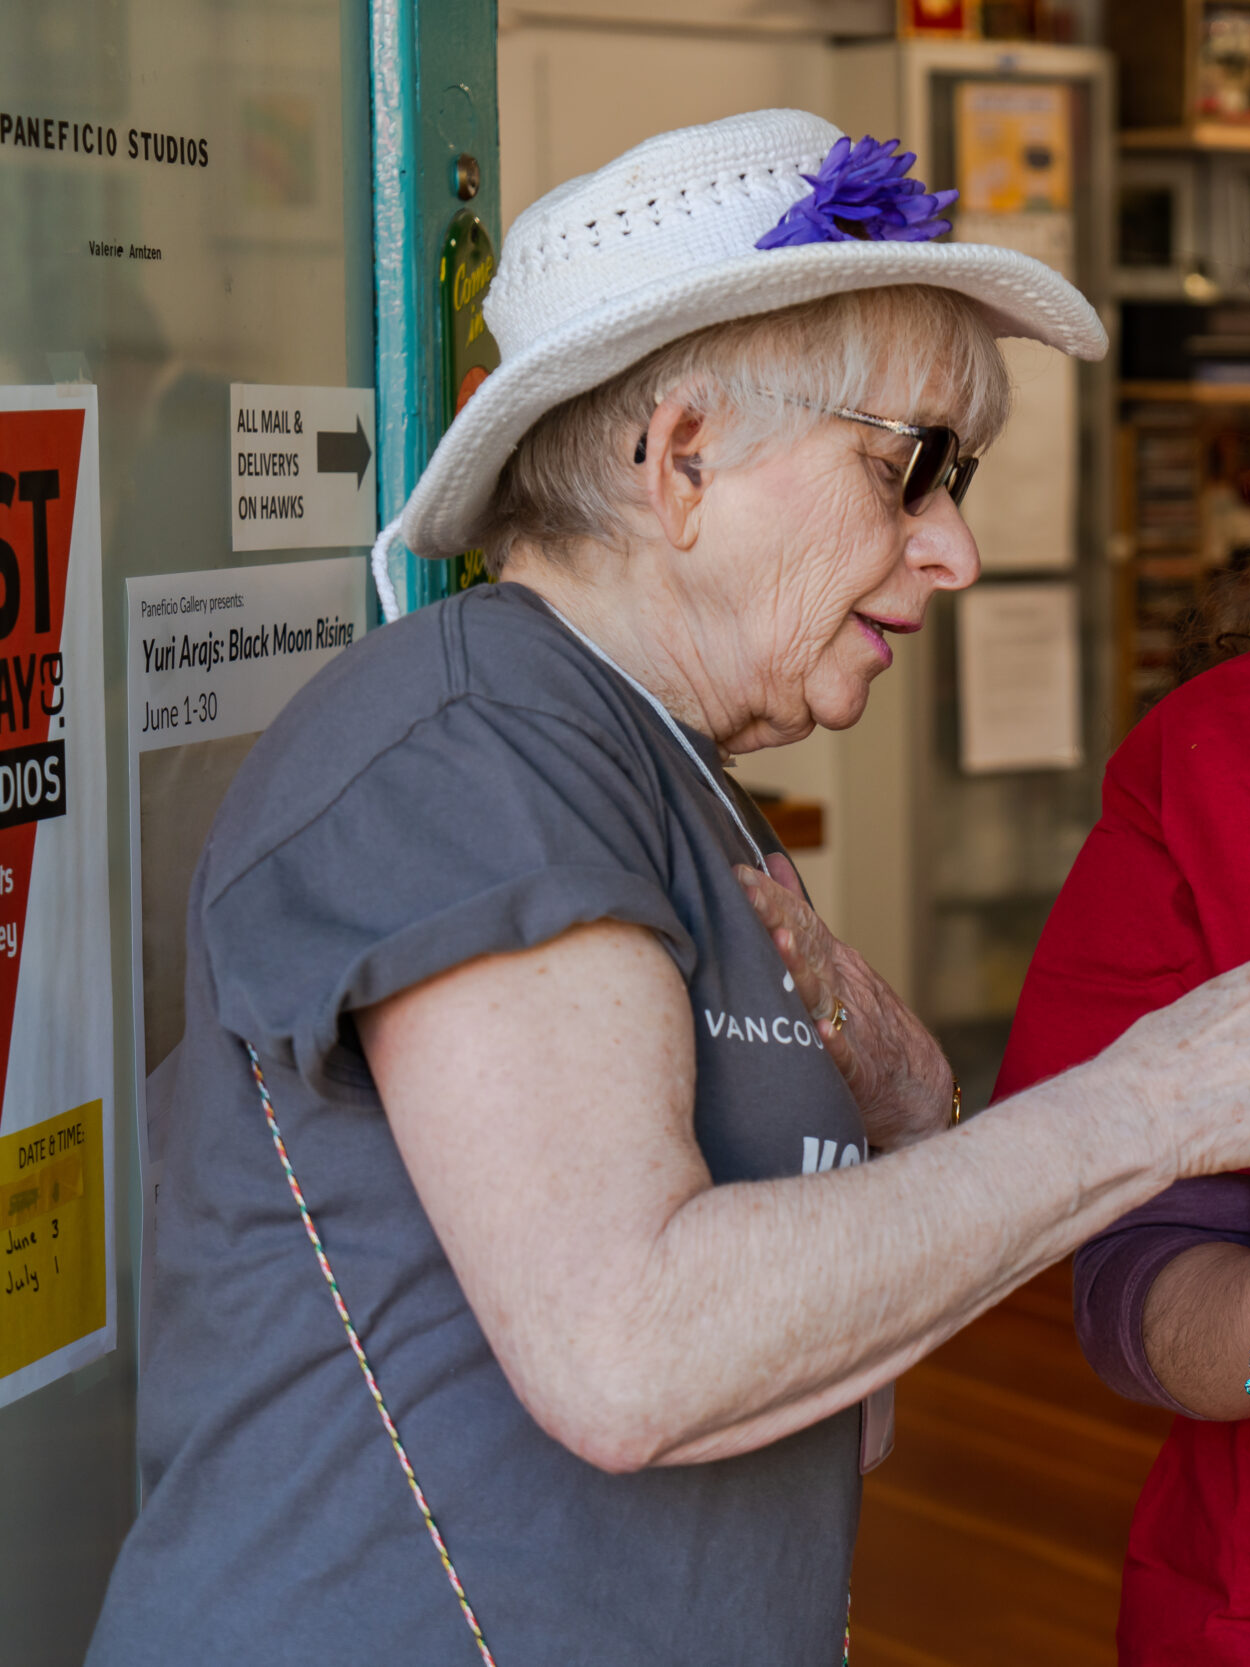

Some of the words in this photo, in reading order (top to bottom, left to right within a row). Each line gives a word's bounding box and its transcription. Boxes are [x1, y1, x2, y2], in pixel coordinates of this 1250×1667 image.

[0, 113, 117, 157] PANEFICIO
[128, 128, 209, 167] STUDIOS
[88, 240, 124, 258] Valerie
[129, 243, 162, 260] Arntzen
[237, 408, 258, 433] ALL
[261, 409, 291, 434] MAIL
[293, 409, 304, 434] &
[238, 452, 300, 477] DELIVERYS
[238, 495, 257, 520] ON
[260, 495, 304, 519] HAWKS
[141, 597, 178, 618] Paneficio
[179, 593, 208, 614] Gallery
[209, 592, 244, 614] presents:
[142, 635, 176, 673] Yuri
[178, 631, 224, 672] Arajs:
[228, 624, 269, 662] Black
[273, 622, 312, 655] Moon
[315, 615, 354, 648] Rising
[142, 701, 179, 732] June
[183, 691, 218, 725] 1-30
[18, 1138, 46, 1169] DATE
[49, 1134, 56, 1157] &
[57, 1123, 85, 1152] TIME:
[6, 1229, 38, 1254] June
[52, 1218, 59, 1239] 3
[6, 1264, 39, 1295] July
